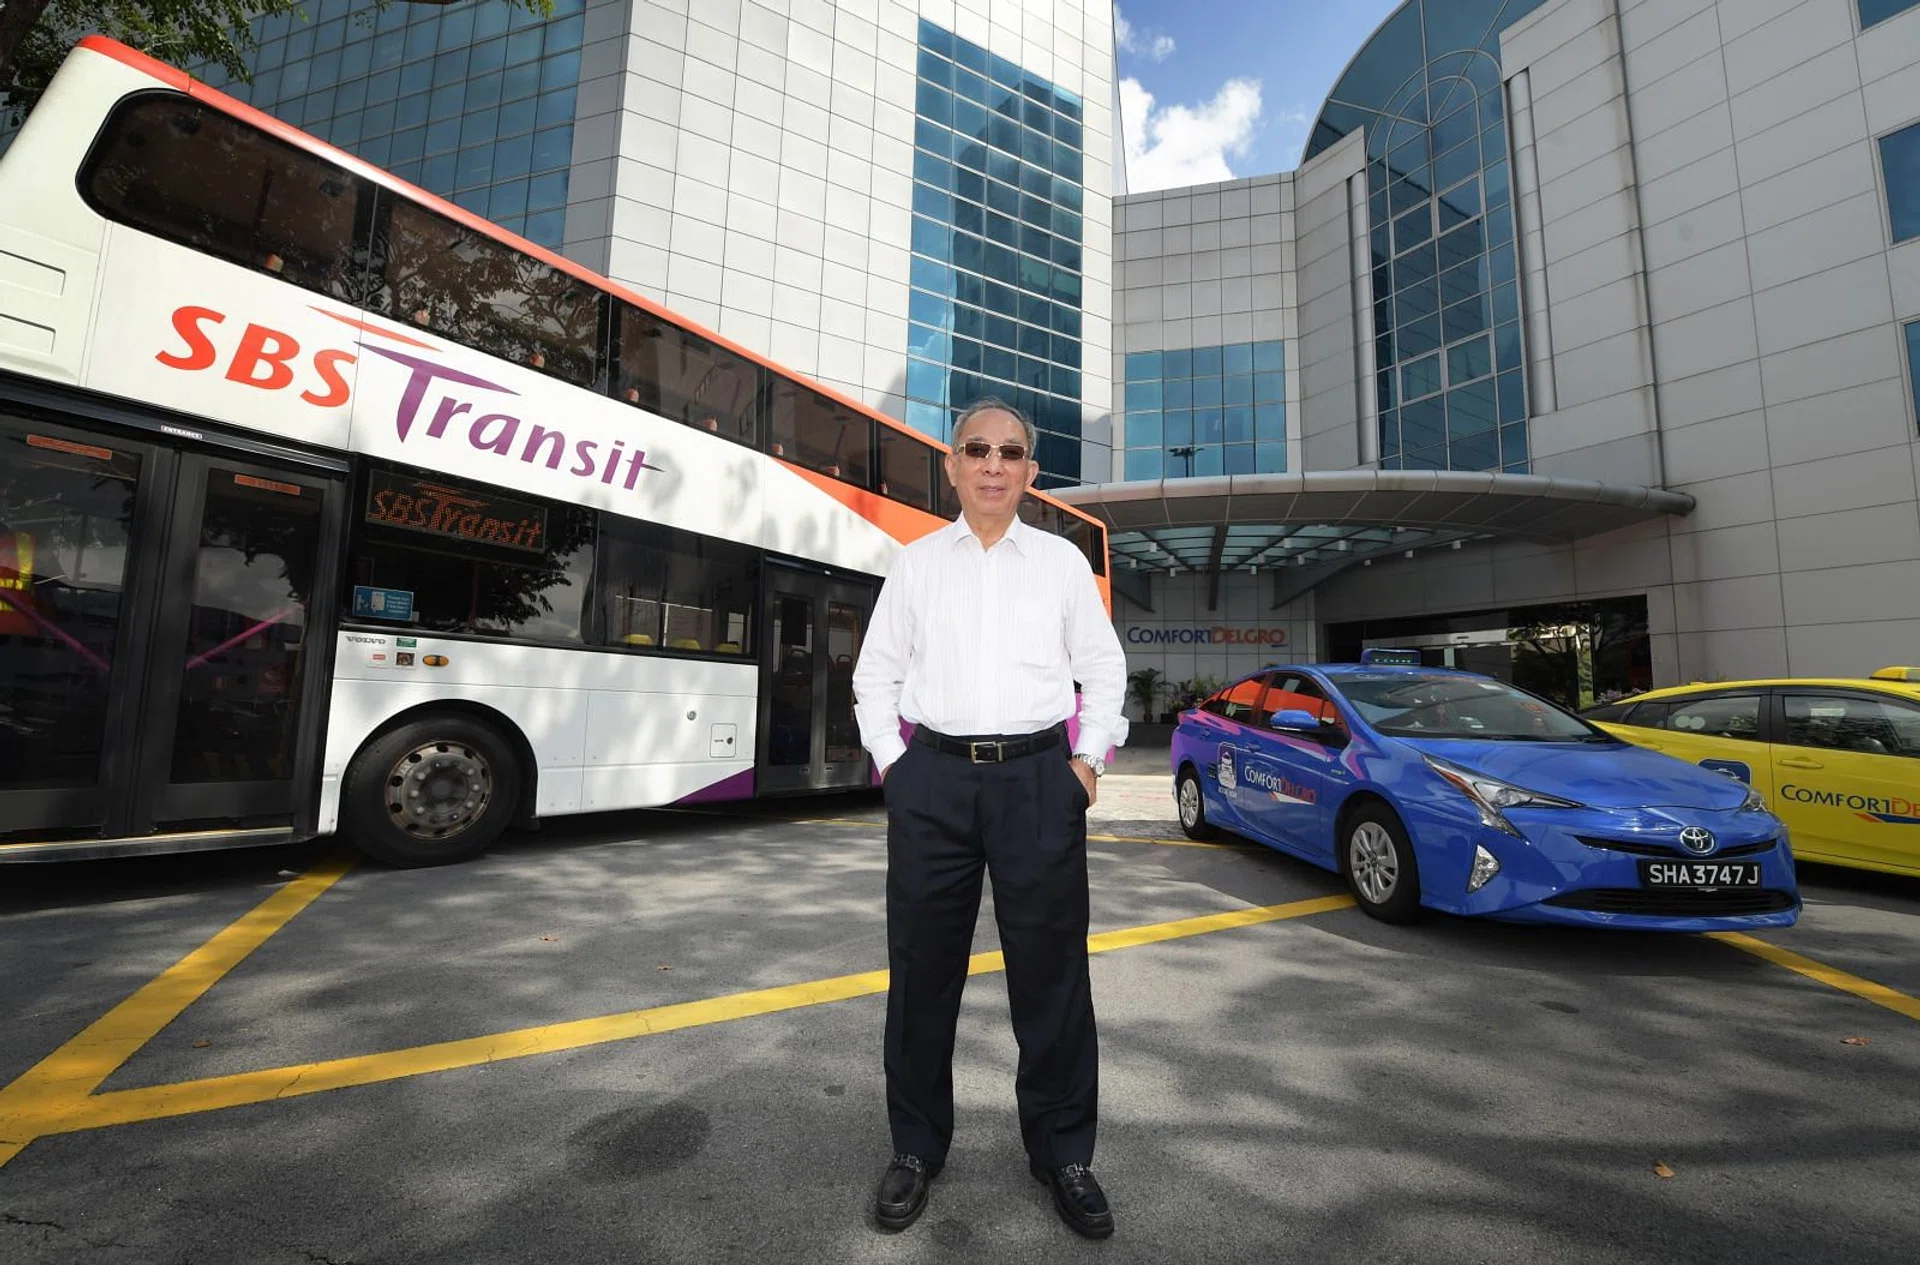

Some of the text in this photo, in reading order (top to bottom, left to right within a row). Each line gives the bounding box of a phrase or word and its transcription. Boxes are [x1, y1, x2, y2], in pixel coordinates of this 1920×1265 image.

[155, 305, 666, 490] SBS Transit
[346, 636, 386, 645] VOLVO
